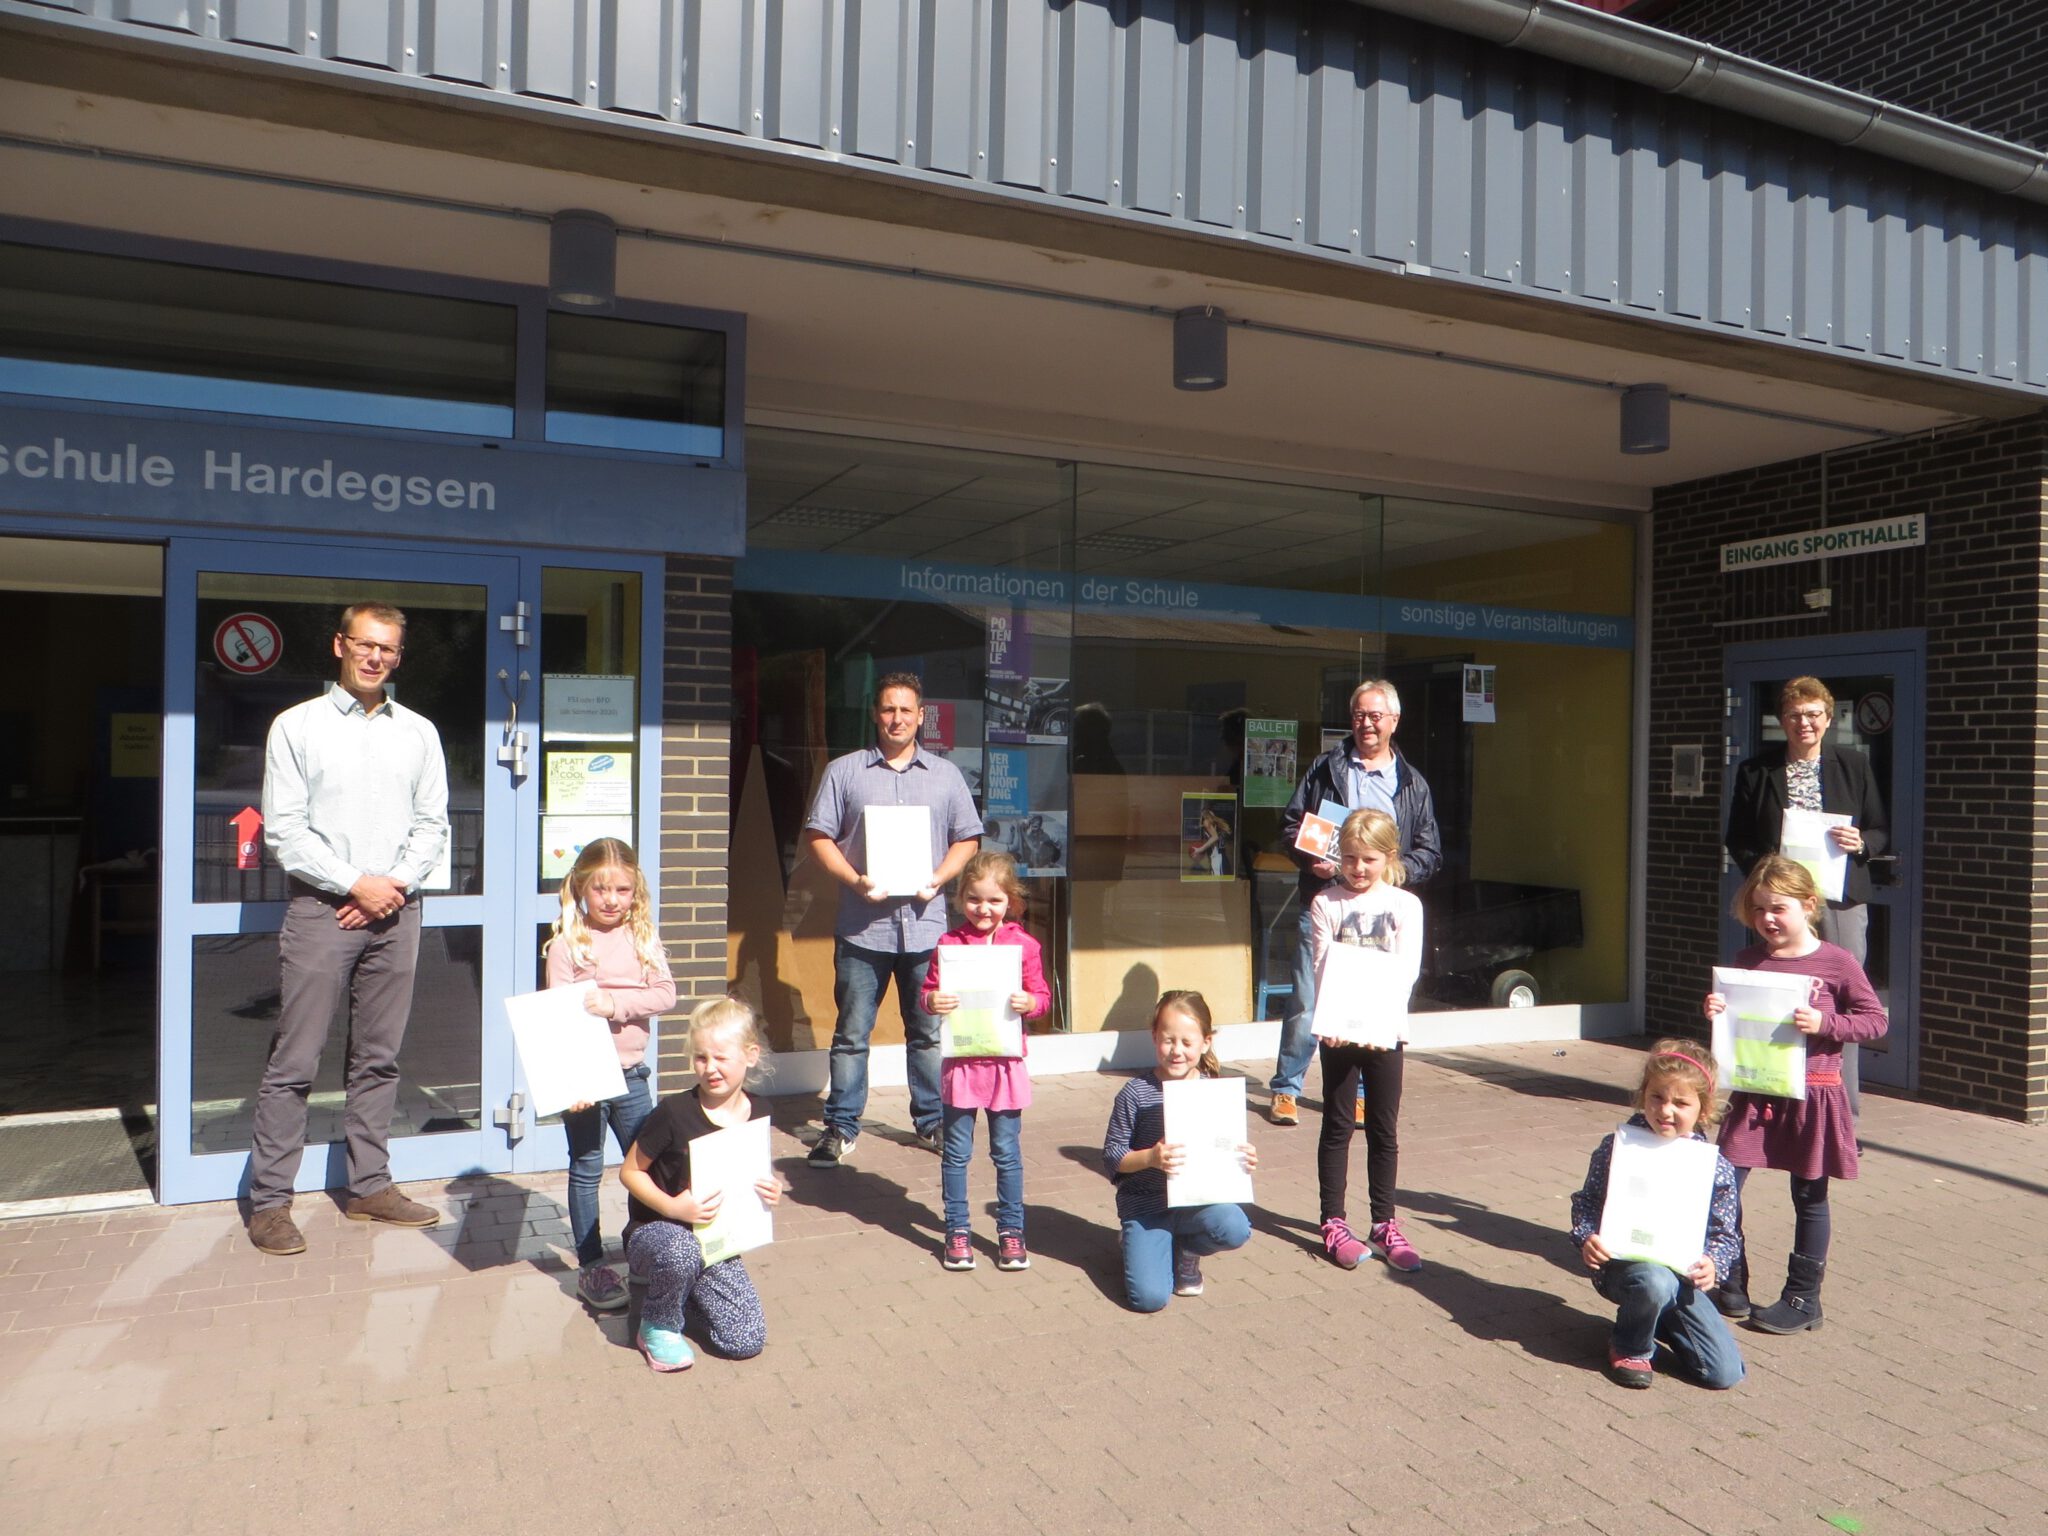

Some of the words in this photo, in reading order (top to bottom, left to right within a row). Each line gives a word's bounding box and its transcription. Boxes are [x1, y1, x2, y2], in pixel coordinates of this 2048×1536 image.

[204, 449, 497, 513] Hardegsen
[1725, 539, 1799, 566] EINGANG
[1802, 521, 1919, 555] SPORTHALLE
[901, 565, 1064, 599] Informationen
[1081, 578, 1119, 602] der
[1125, 581, 1199, 608] Schule
[990, 617, 1006, 629] PO
[1400, 605, 1477, 631] sonstige
[1482, 608, 1618, 641] Veranstaltungen
[990, 629, 1012, 641] TEN
[989, 641, 1007, 653] TIA
[989, 652, 1003, 664] LE
[1248, 720, 1297, 734] BALLETT
[923, 730, 941, 739] UNG
[559, 758, 585, 766] PLATT
[988, 752, 1009, 764] VER
[559, 771, 585, 779] COOL
[988, 764, 1009, 776] ANT
[988, 776, 1018, 788] WORT
[988, 788, 1011, 800] UNG
